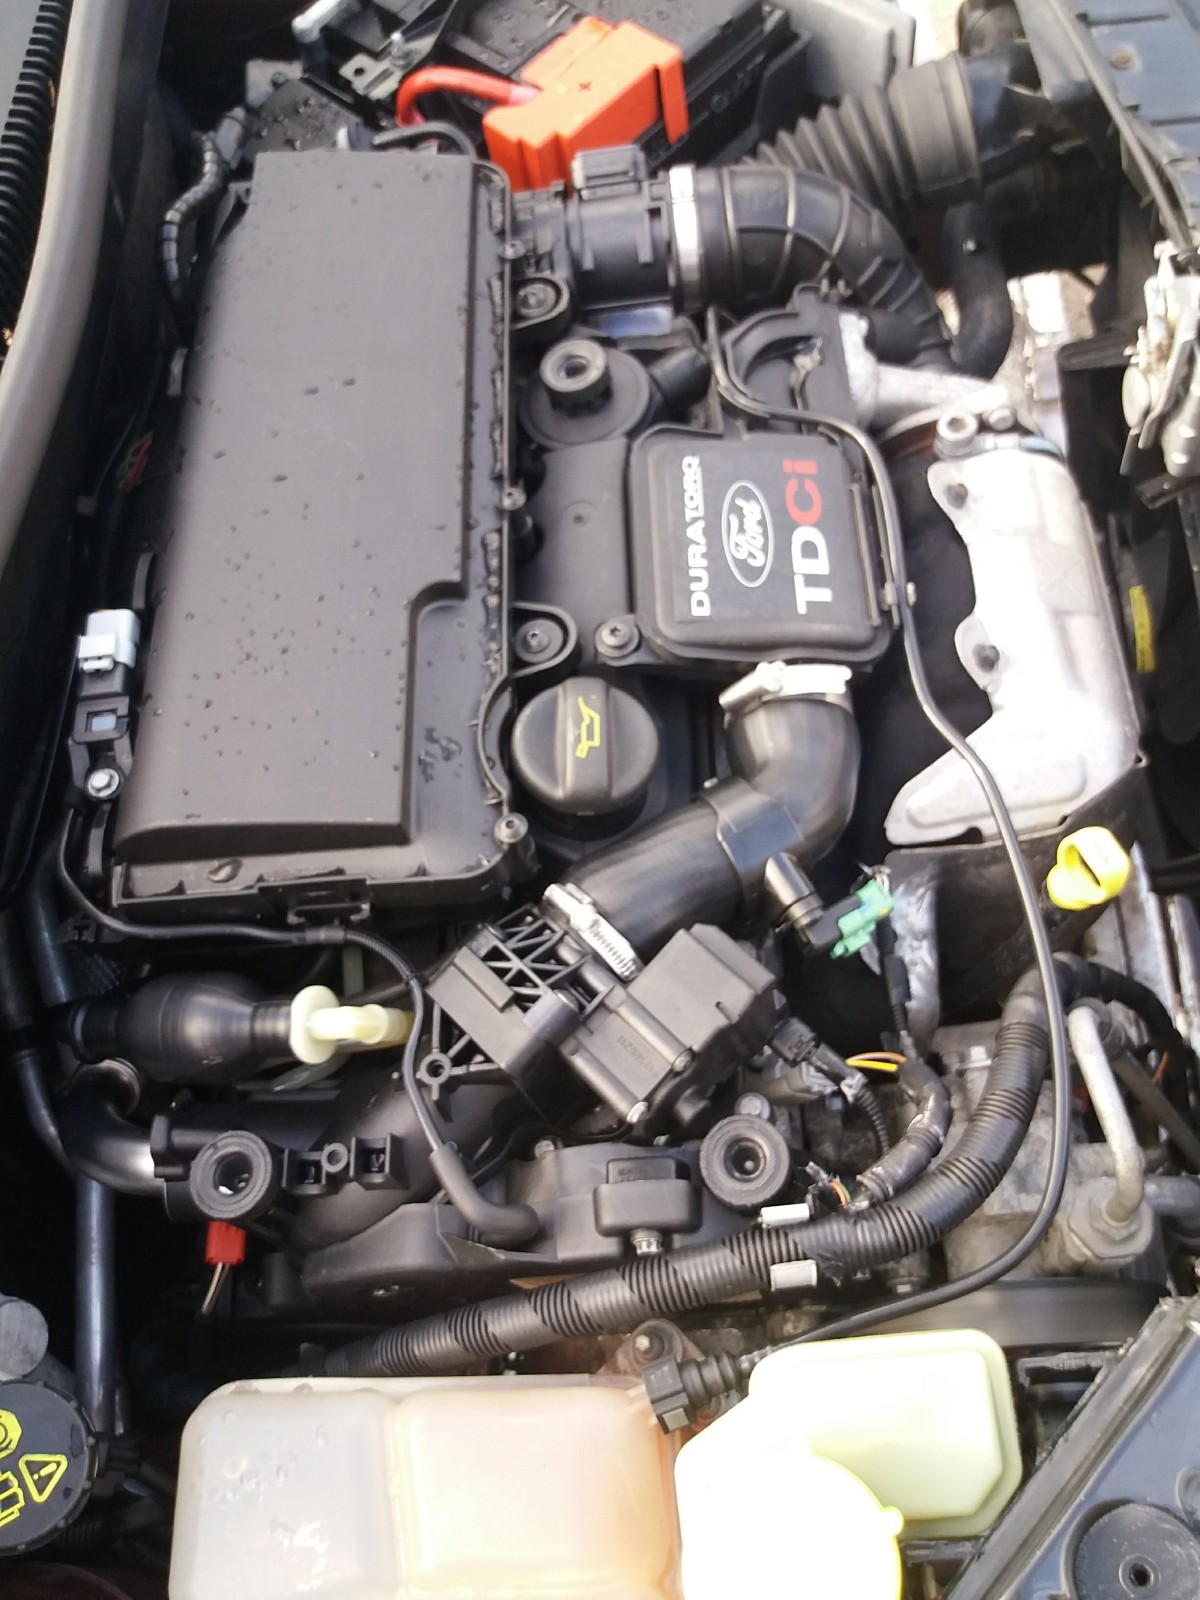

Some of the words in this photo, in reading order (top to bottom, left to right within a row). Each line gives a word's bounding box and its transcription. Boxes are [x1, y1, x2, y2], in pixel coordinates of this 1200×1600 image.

[681, 455, 712, 617] DURATORQ
[727, 495, 768, 569] Ford
[782, 459, 833, 615] TDCi
